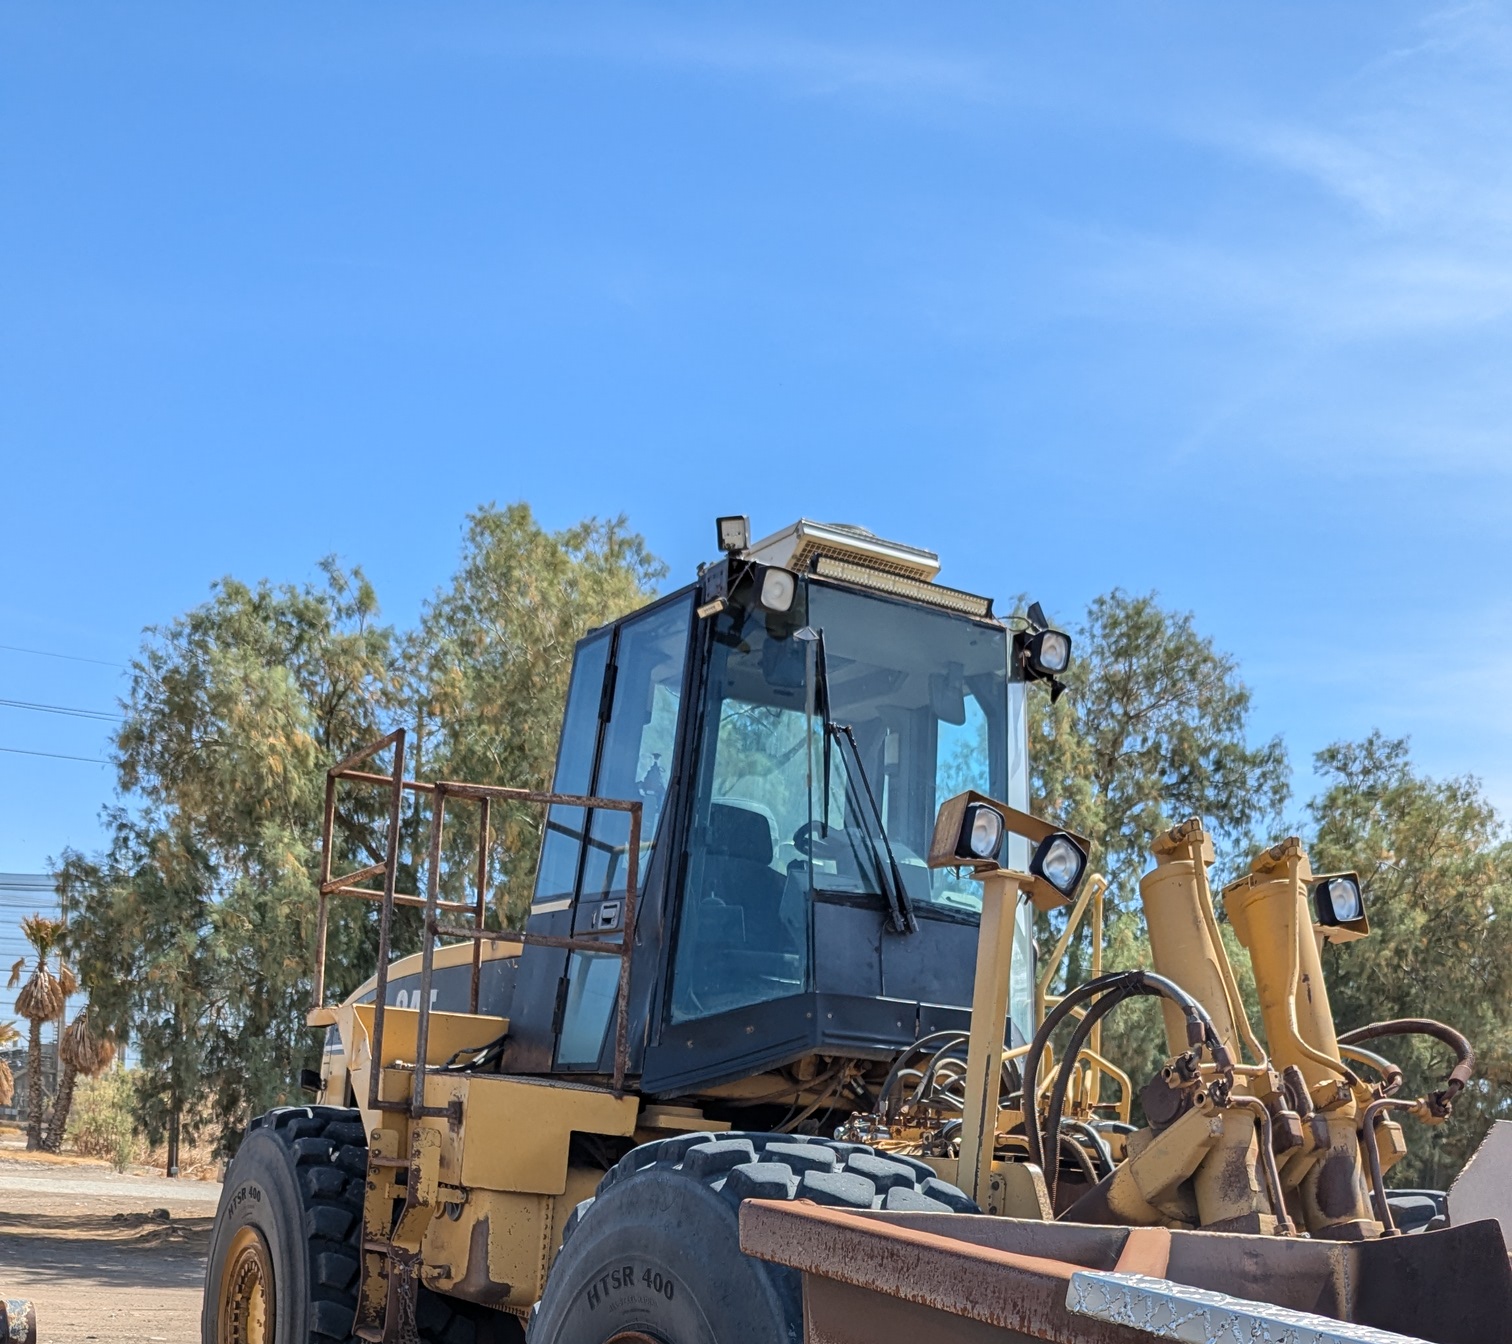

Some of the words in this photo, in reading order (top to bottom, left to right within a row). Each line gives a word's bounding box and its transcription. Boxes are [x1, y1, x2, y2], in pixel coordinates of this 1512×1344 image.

[228, 1187, 247, 1220] HTSR
[249, 1186, 261, 1202] 400
[587, 1265, 635, 1311] HTSR
[642, 1267, 674, 1301] 400
